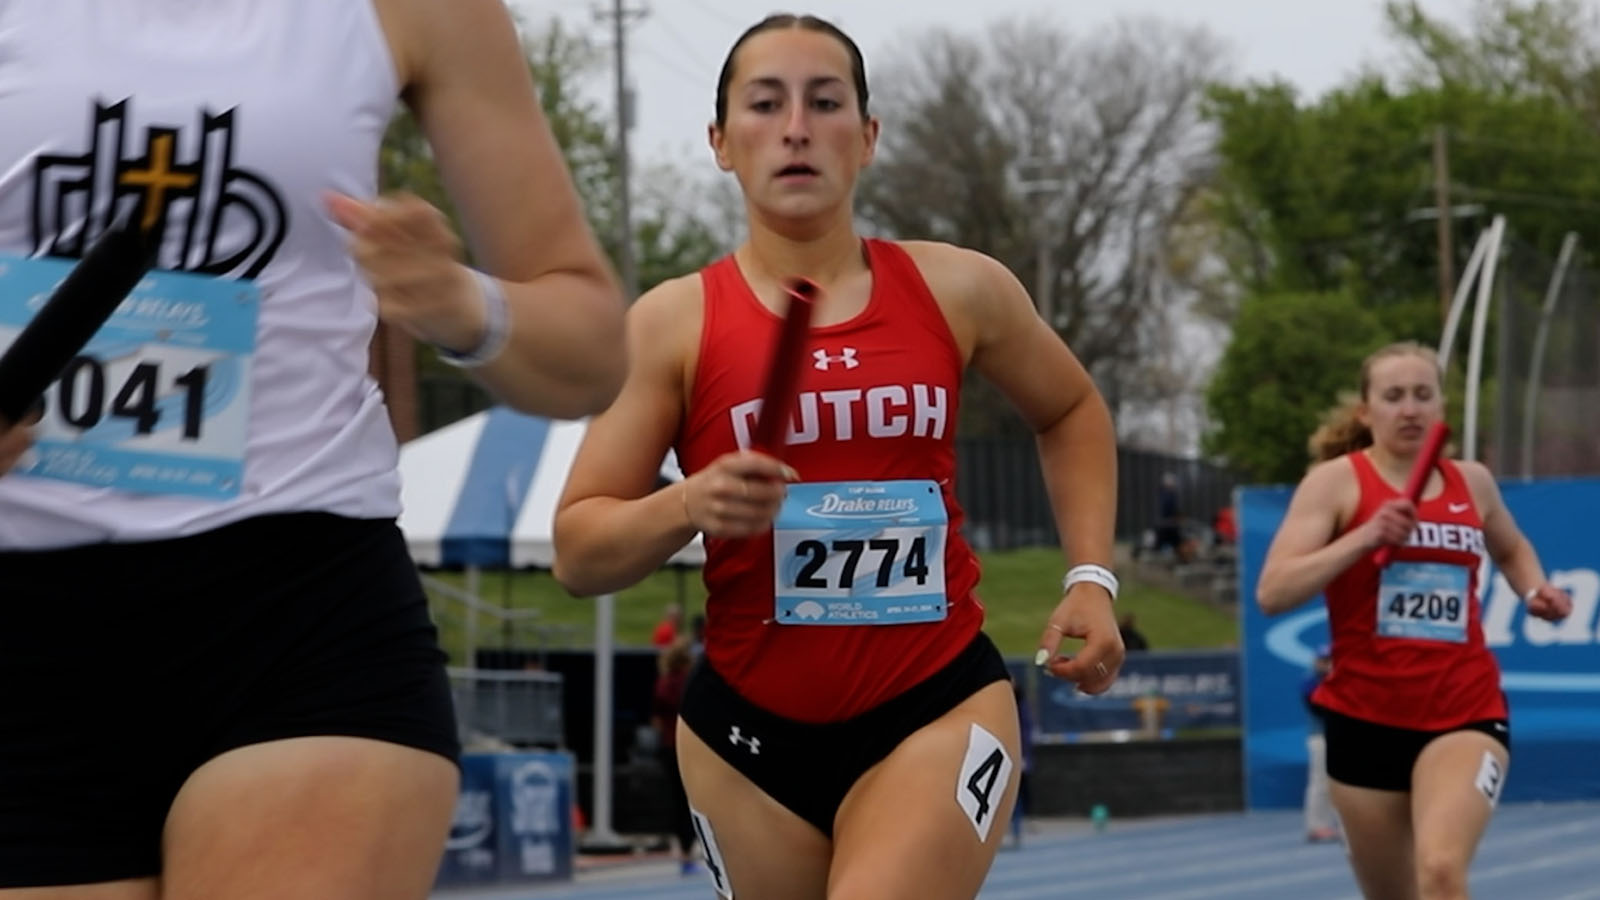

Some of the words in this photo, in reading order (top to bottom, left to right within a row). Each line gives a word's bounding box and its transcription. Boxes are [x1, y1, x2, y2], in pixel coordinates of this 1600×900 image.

[30, 355, 210, 441] 041
[822, 493, 876, 513] Drake
[876, 498, 915, 511] RELAYS
[795, 536, 928, 589] 2774
[828, 610, 878, 619] ATHLETICS
[1388, 593, 1461, 621] 4209
[967, 748, 1004, 824] 4
